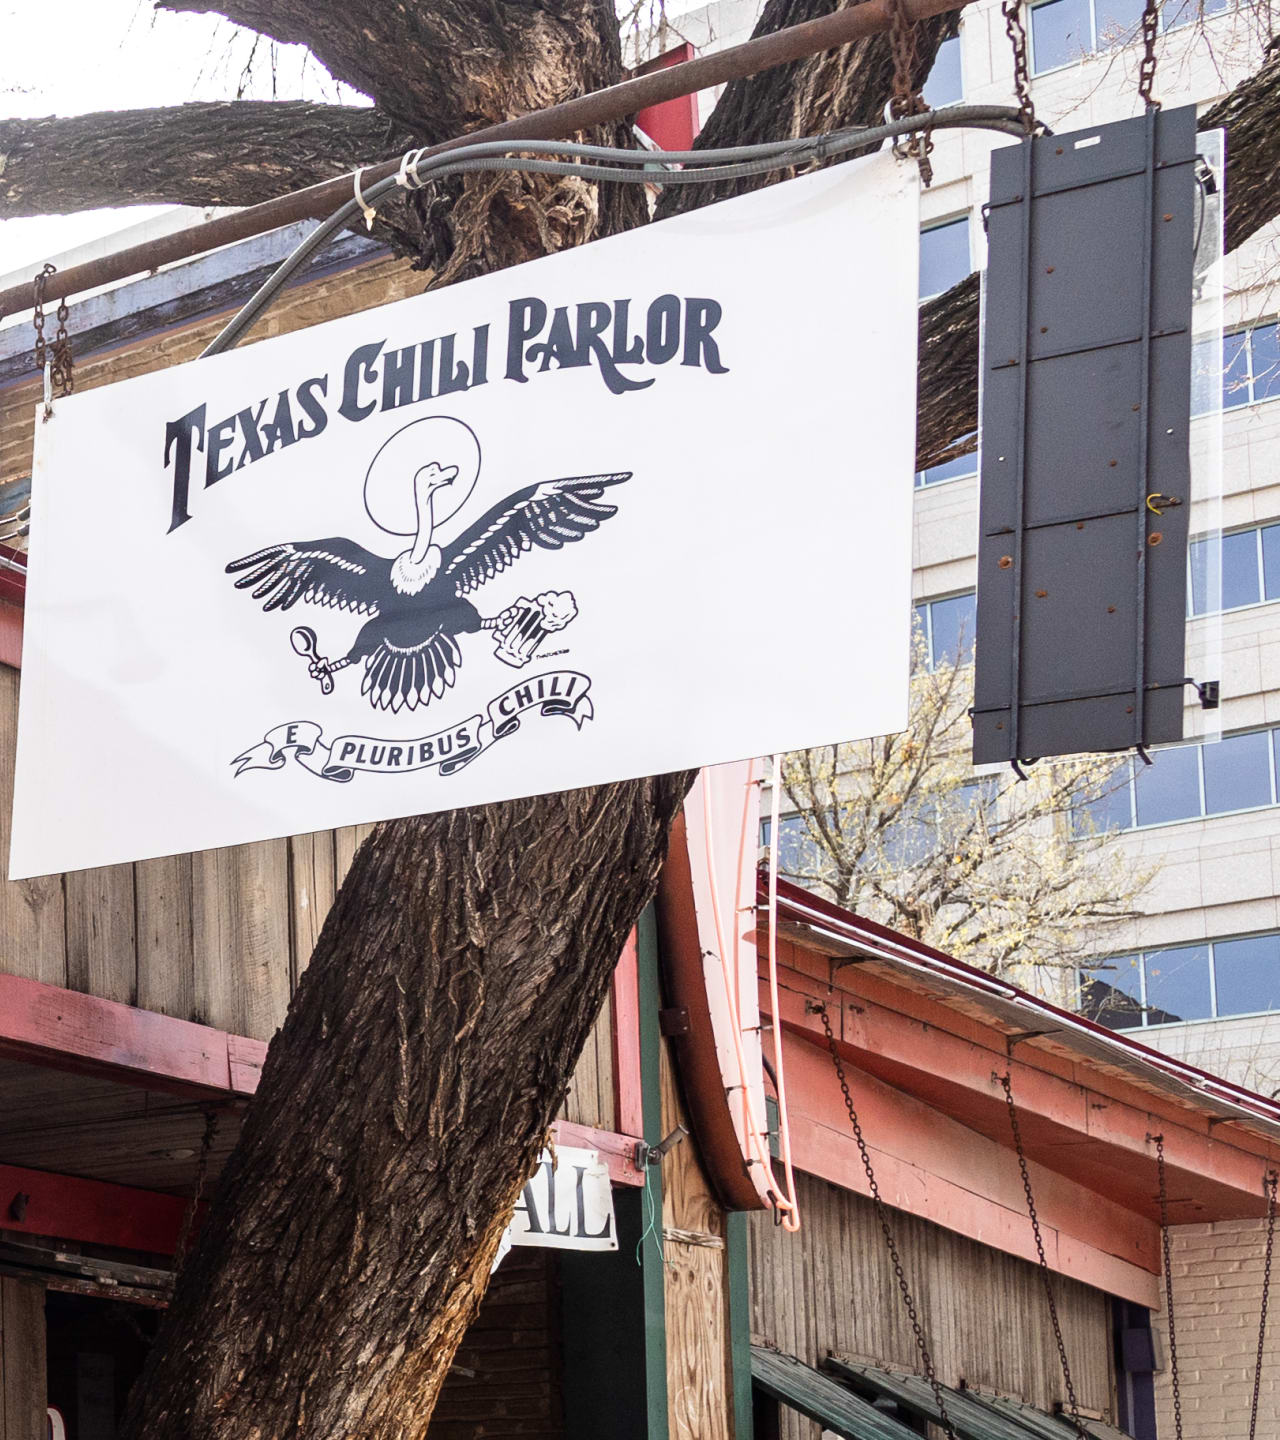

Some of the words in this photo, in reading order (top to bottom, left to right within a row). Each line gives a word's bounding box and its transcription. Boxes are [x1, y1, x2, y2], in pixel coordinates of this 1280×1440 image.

[163, 372, 330, 536] TEXAS
[337, 323, 491, 422] CHILI
[503, 294, 730, 395] PARLOR
[285, 724, 299, 745] E
[339, 727, 471, 767] PLURIBUS
[498, 676, 577, 716] CHILI
